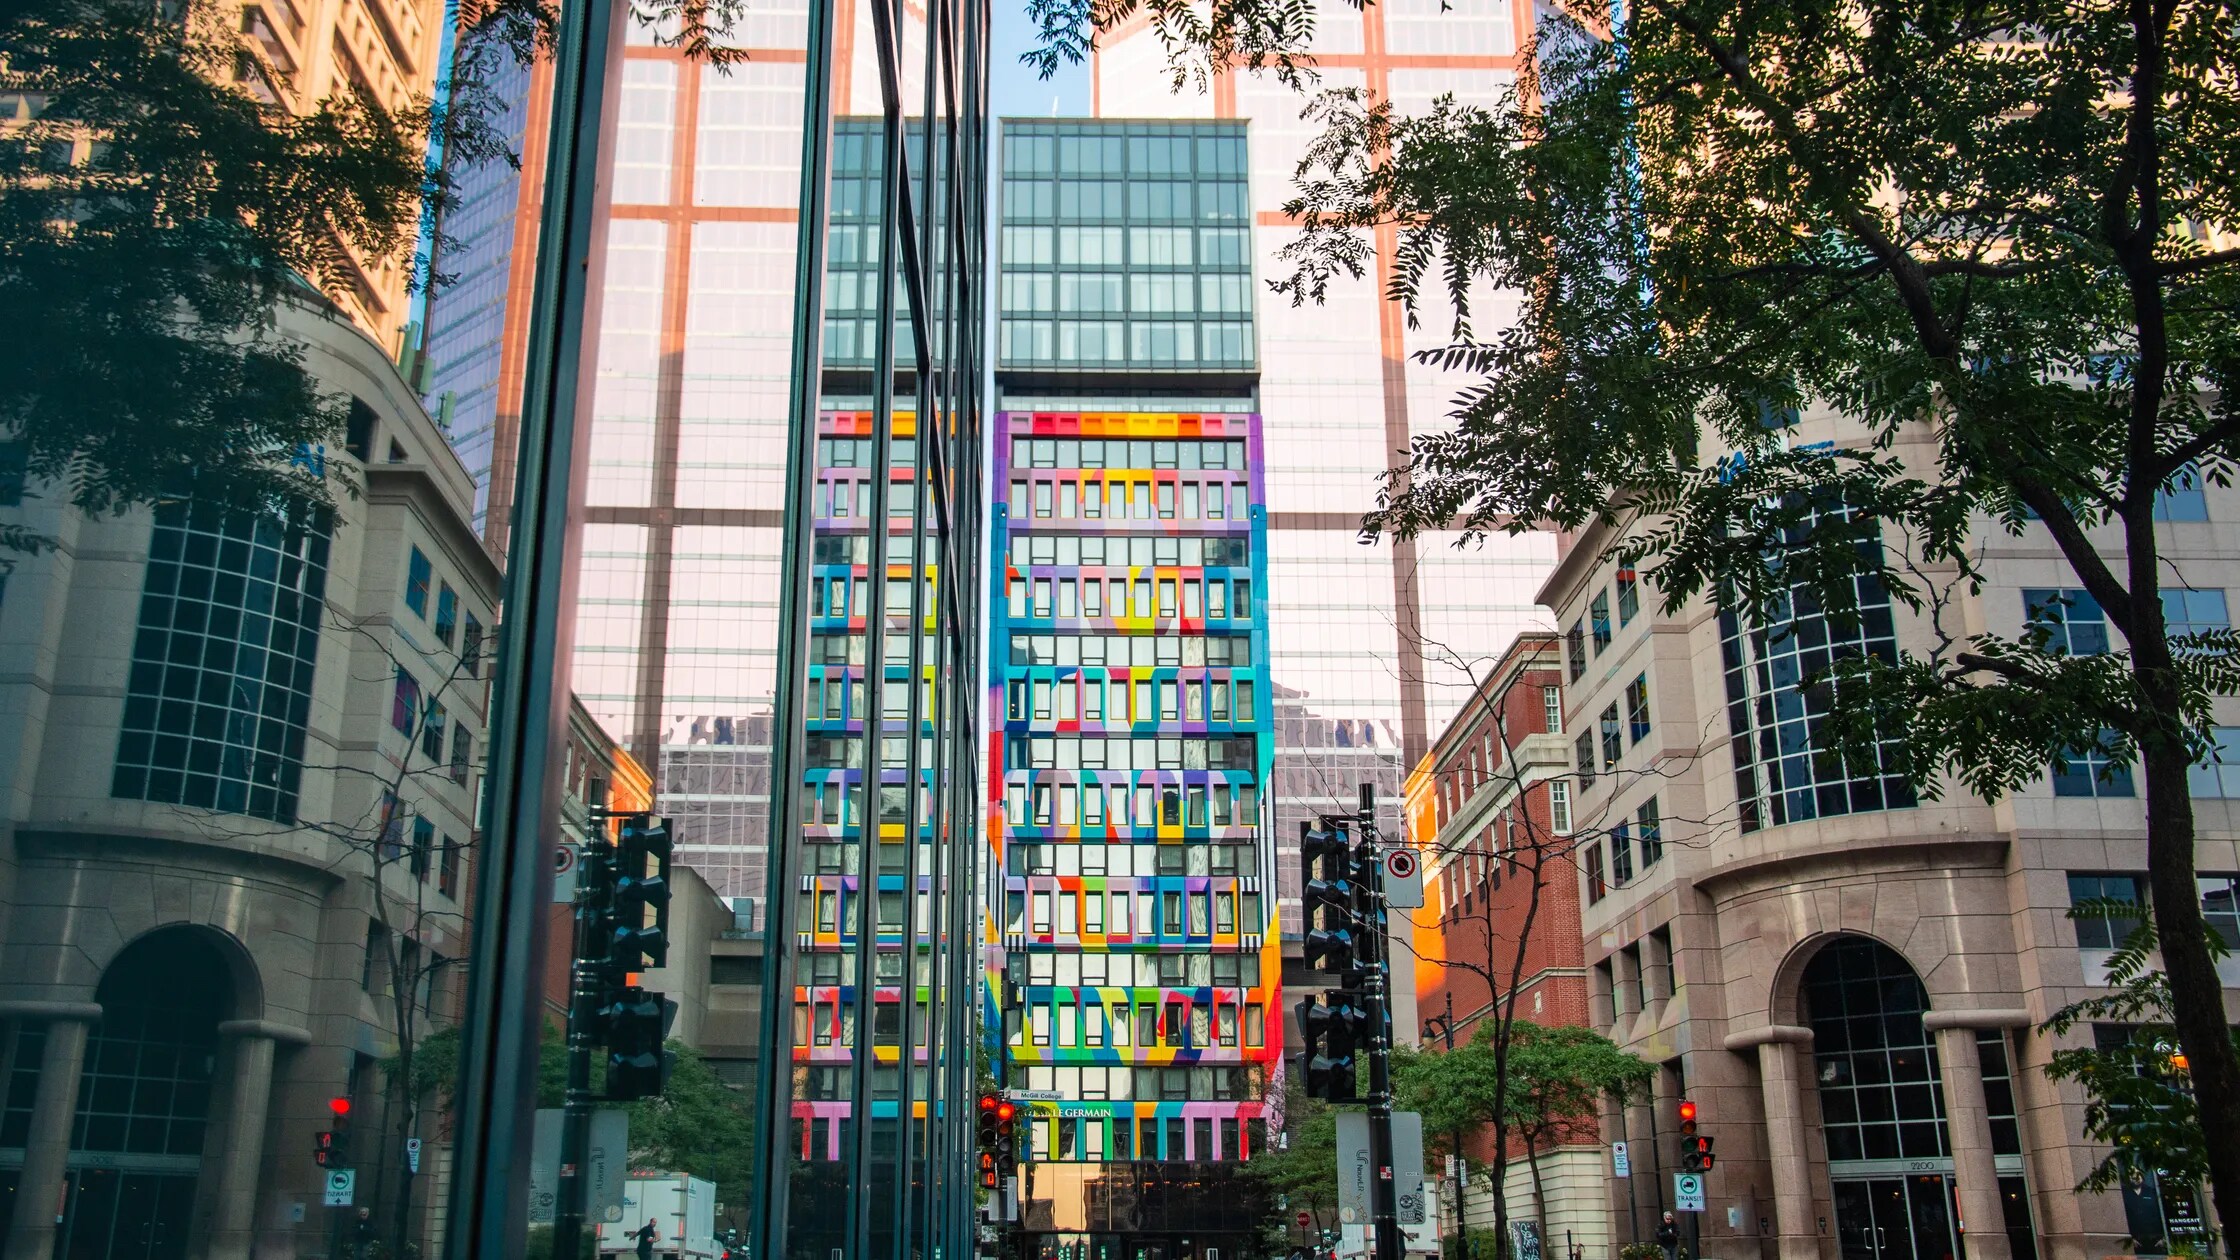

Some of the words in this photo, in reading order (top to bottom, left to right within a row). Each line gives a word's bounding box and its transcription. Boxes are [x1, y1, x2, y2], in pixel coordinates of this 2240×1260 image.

[1052, 1109, 1063, 1117] LE
[1064, 1109, 1111, 1117] GERMAIN
[1910, 1162, 1934, 1170] 2200
